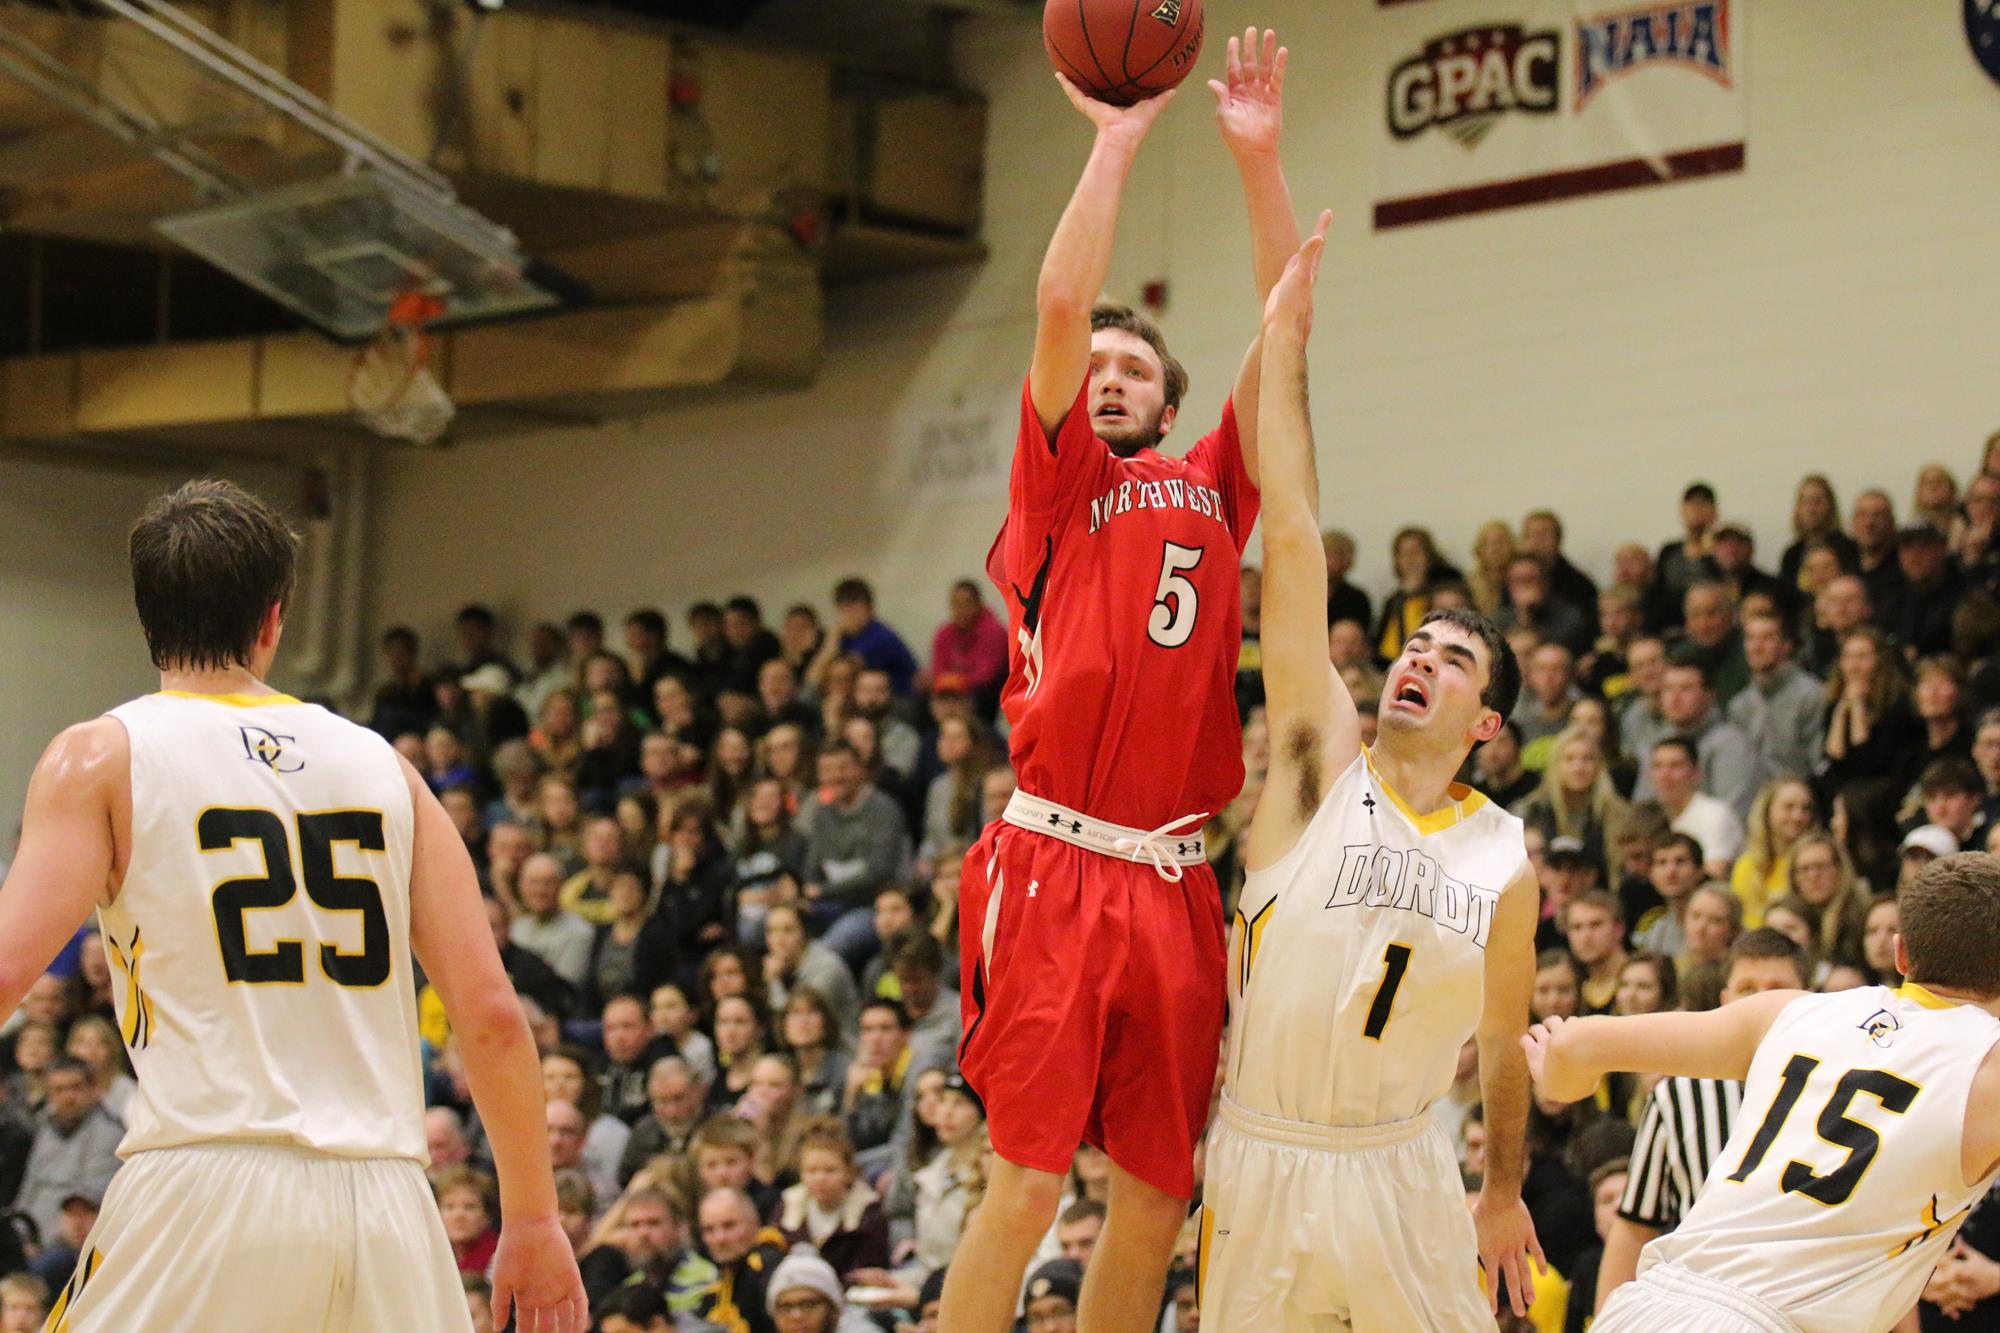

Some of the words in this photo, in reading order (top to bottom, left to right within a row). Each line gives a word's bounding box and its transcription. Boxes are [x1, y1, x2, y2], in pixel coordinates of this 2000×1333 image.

[1391, 32, 1557, 134] GPAC
[1575, 4, 1723, 95] NAIA
[1088, 478, 1229, 535] NORTHWEST
[1146, 539, 1205, 649] 5
[194, 805, 391, 991] 25
[1325, 843, 1500, 949] DORDT
[1361, 942, 1414, 1043] 1
[1724, 1052, 1923, 1208] 15
